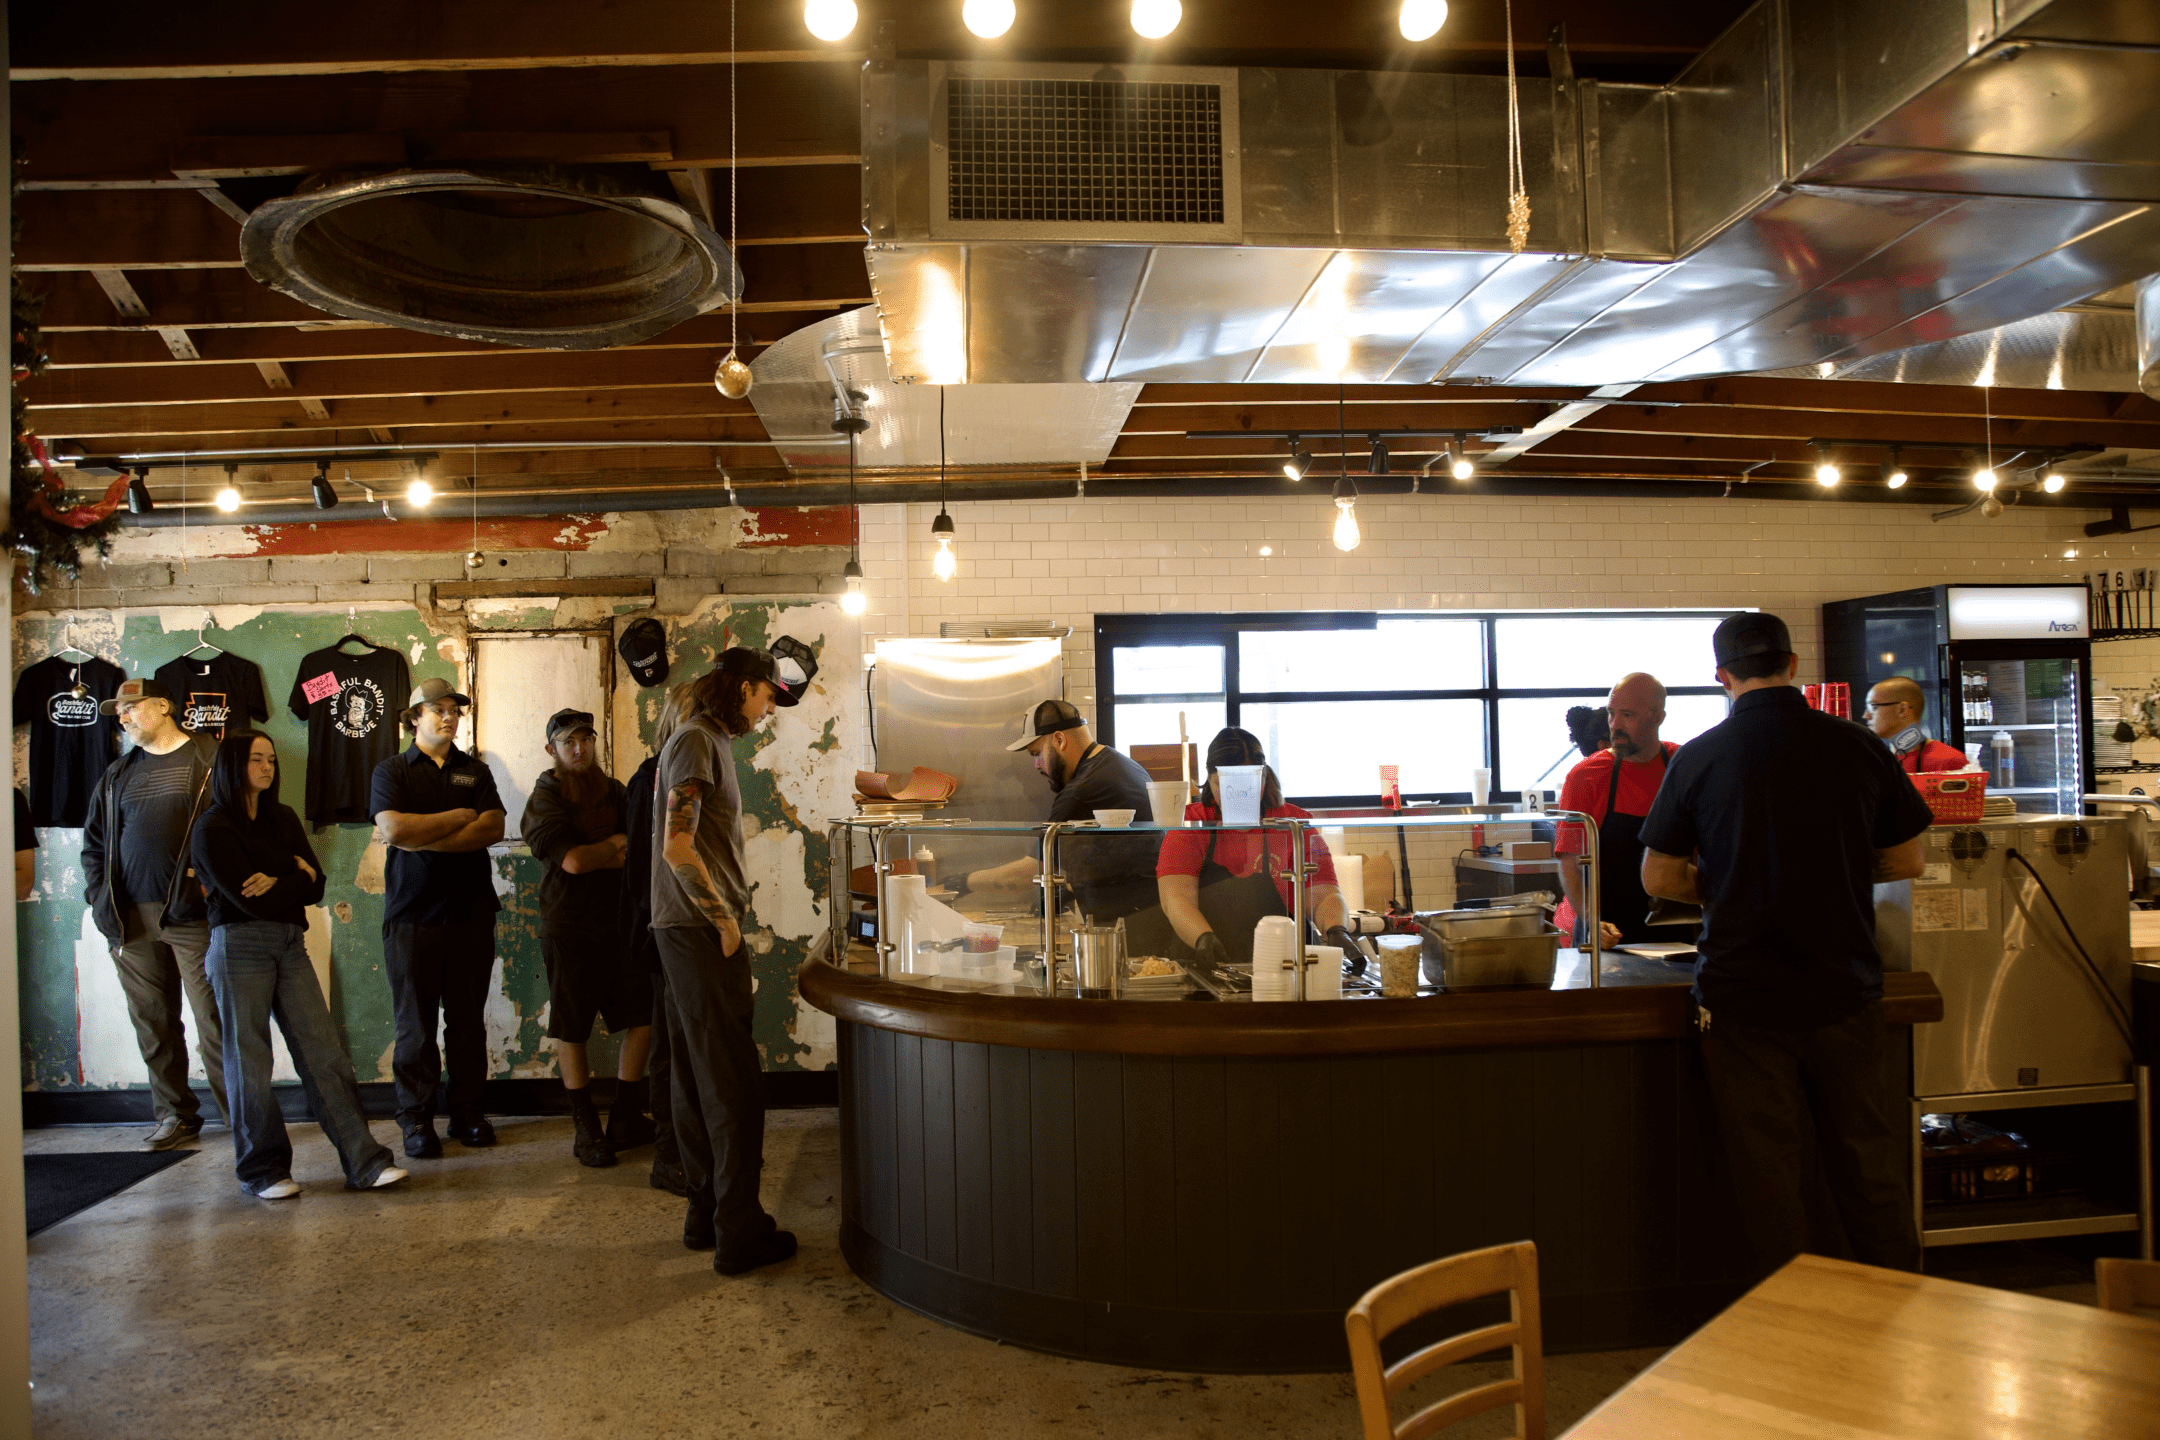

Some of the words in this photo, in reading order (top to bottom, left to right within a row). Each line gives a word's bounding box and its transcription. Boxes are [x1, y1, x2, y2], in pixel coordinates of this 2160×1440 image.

[2098, 573, 2107, 587] 7
[2116, 572, 2123, 586] 6
[364, 679, 384, 715] BANDIT
[181, 706, 231, 730] Bandit
[335, 720, 377, 738] BARBEUE
[1530, 794, 1537, 809] 2
